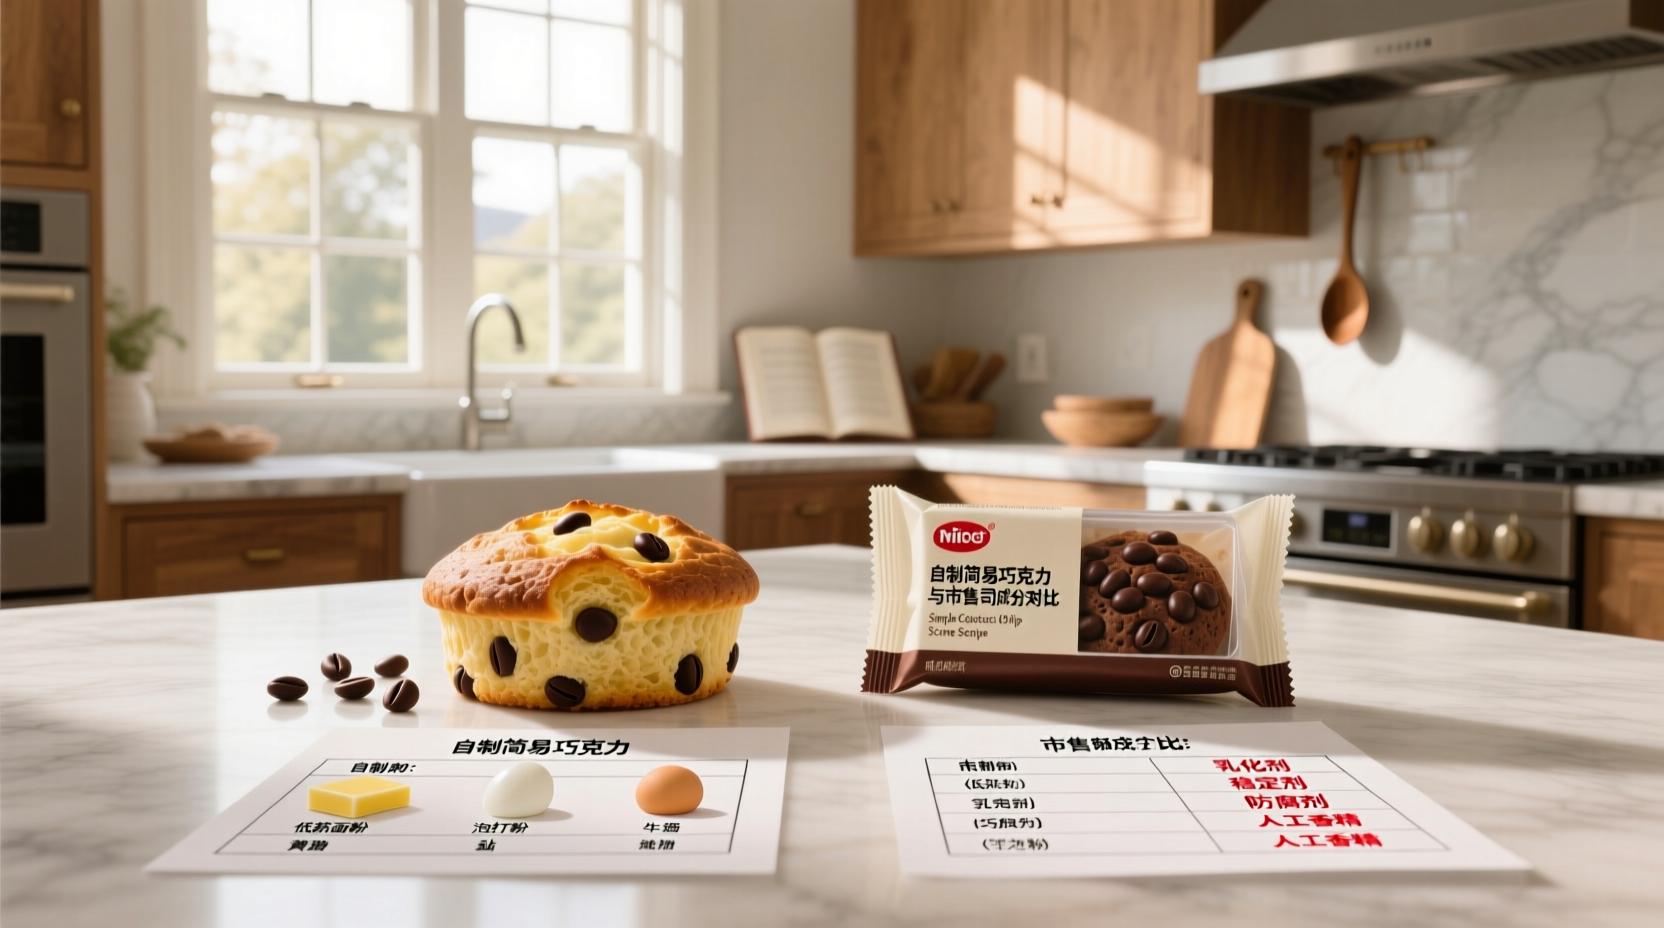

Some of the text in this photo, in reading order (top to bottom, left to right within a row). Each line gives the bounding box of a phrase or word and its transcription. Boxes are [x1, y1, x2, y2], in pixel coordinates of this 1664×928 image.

[930, 564, 1051, 585] 自制简易巧克力
[452, 738, 630, 755] 自制简易巧克力
[1212, 758, 1291, 773] 乳化剂
[1259, 813, 1362, 828] 人工香精
[1274, 833, 1383, 848] 人工香精
